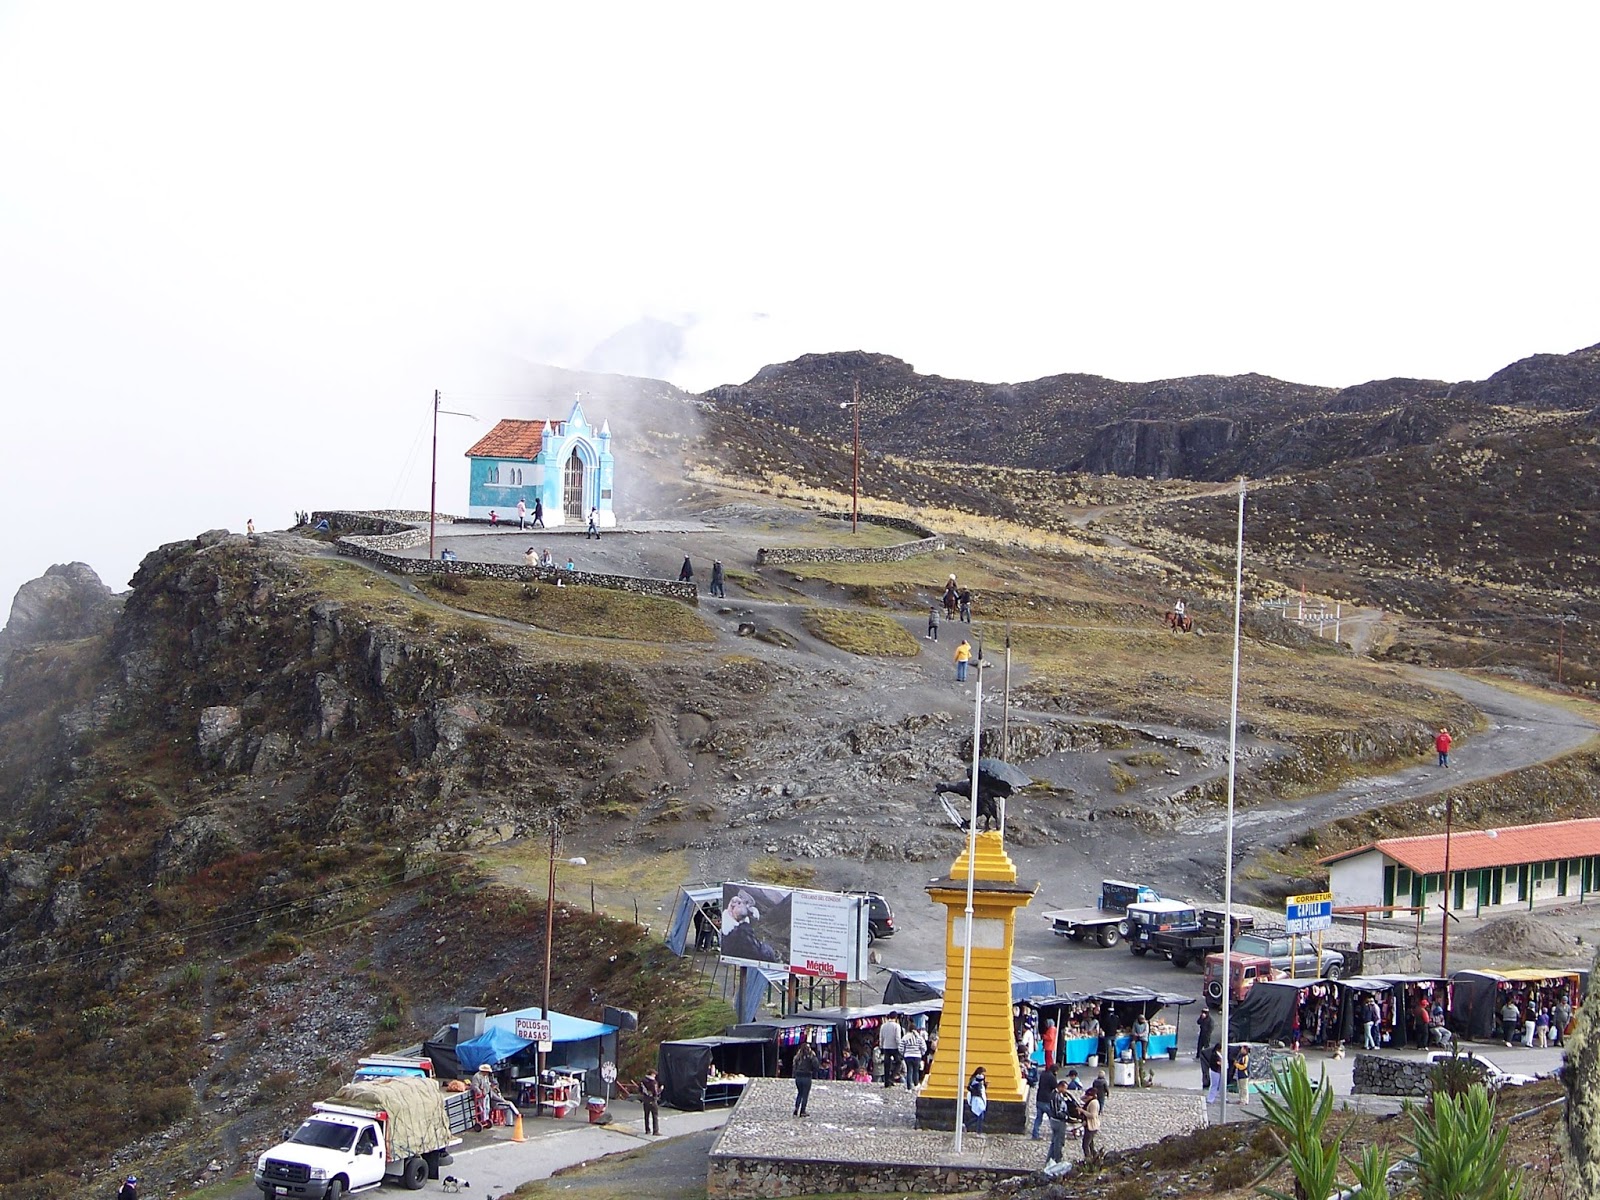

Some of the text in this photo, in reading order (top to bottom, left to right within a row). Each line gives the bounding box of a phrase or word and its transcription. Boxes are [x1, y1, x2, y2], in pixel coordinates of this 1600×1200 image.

[1296, 893, 1332, 903] CORMETUR
[1297, 903, 1322, 917] CAPILLA
[806, 960, 834, 972] Mérida
[518, 1019, 541, 1030] POLLOS
[519, 1030, 547, 1041] BRASAS
